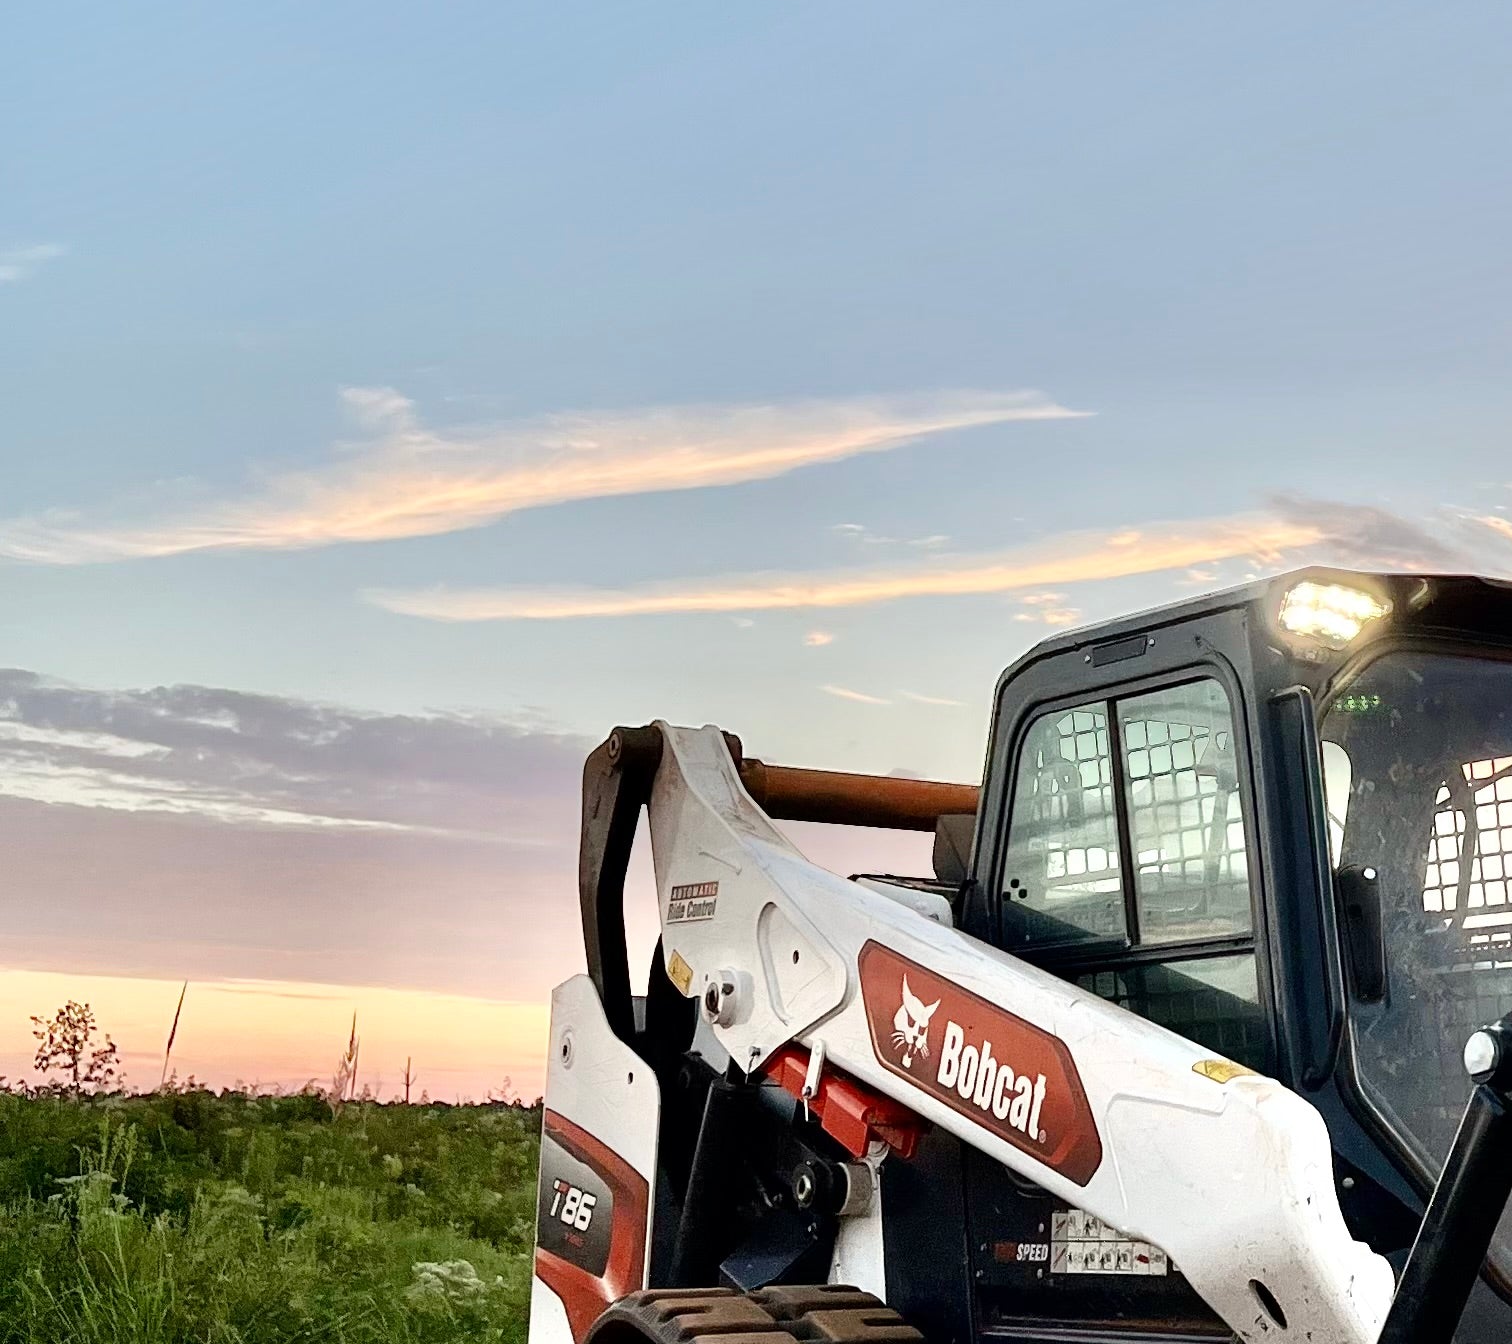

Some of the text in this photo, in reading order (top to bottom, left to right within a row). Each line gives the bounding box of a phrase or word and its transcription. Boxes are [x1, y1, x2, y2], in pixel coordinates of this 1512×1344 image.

[687, 899, 717, 918] Control
[937, 1020, 1046, 1140] Bobcat
[550, 1179, 597, 1231] T86
[1016, 1242, 1049, 1261] SPEED
